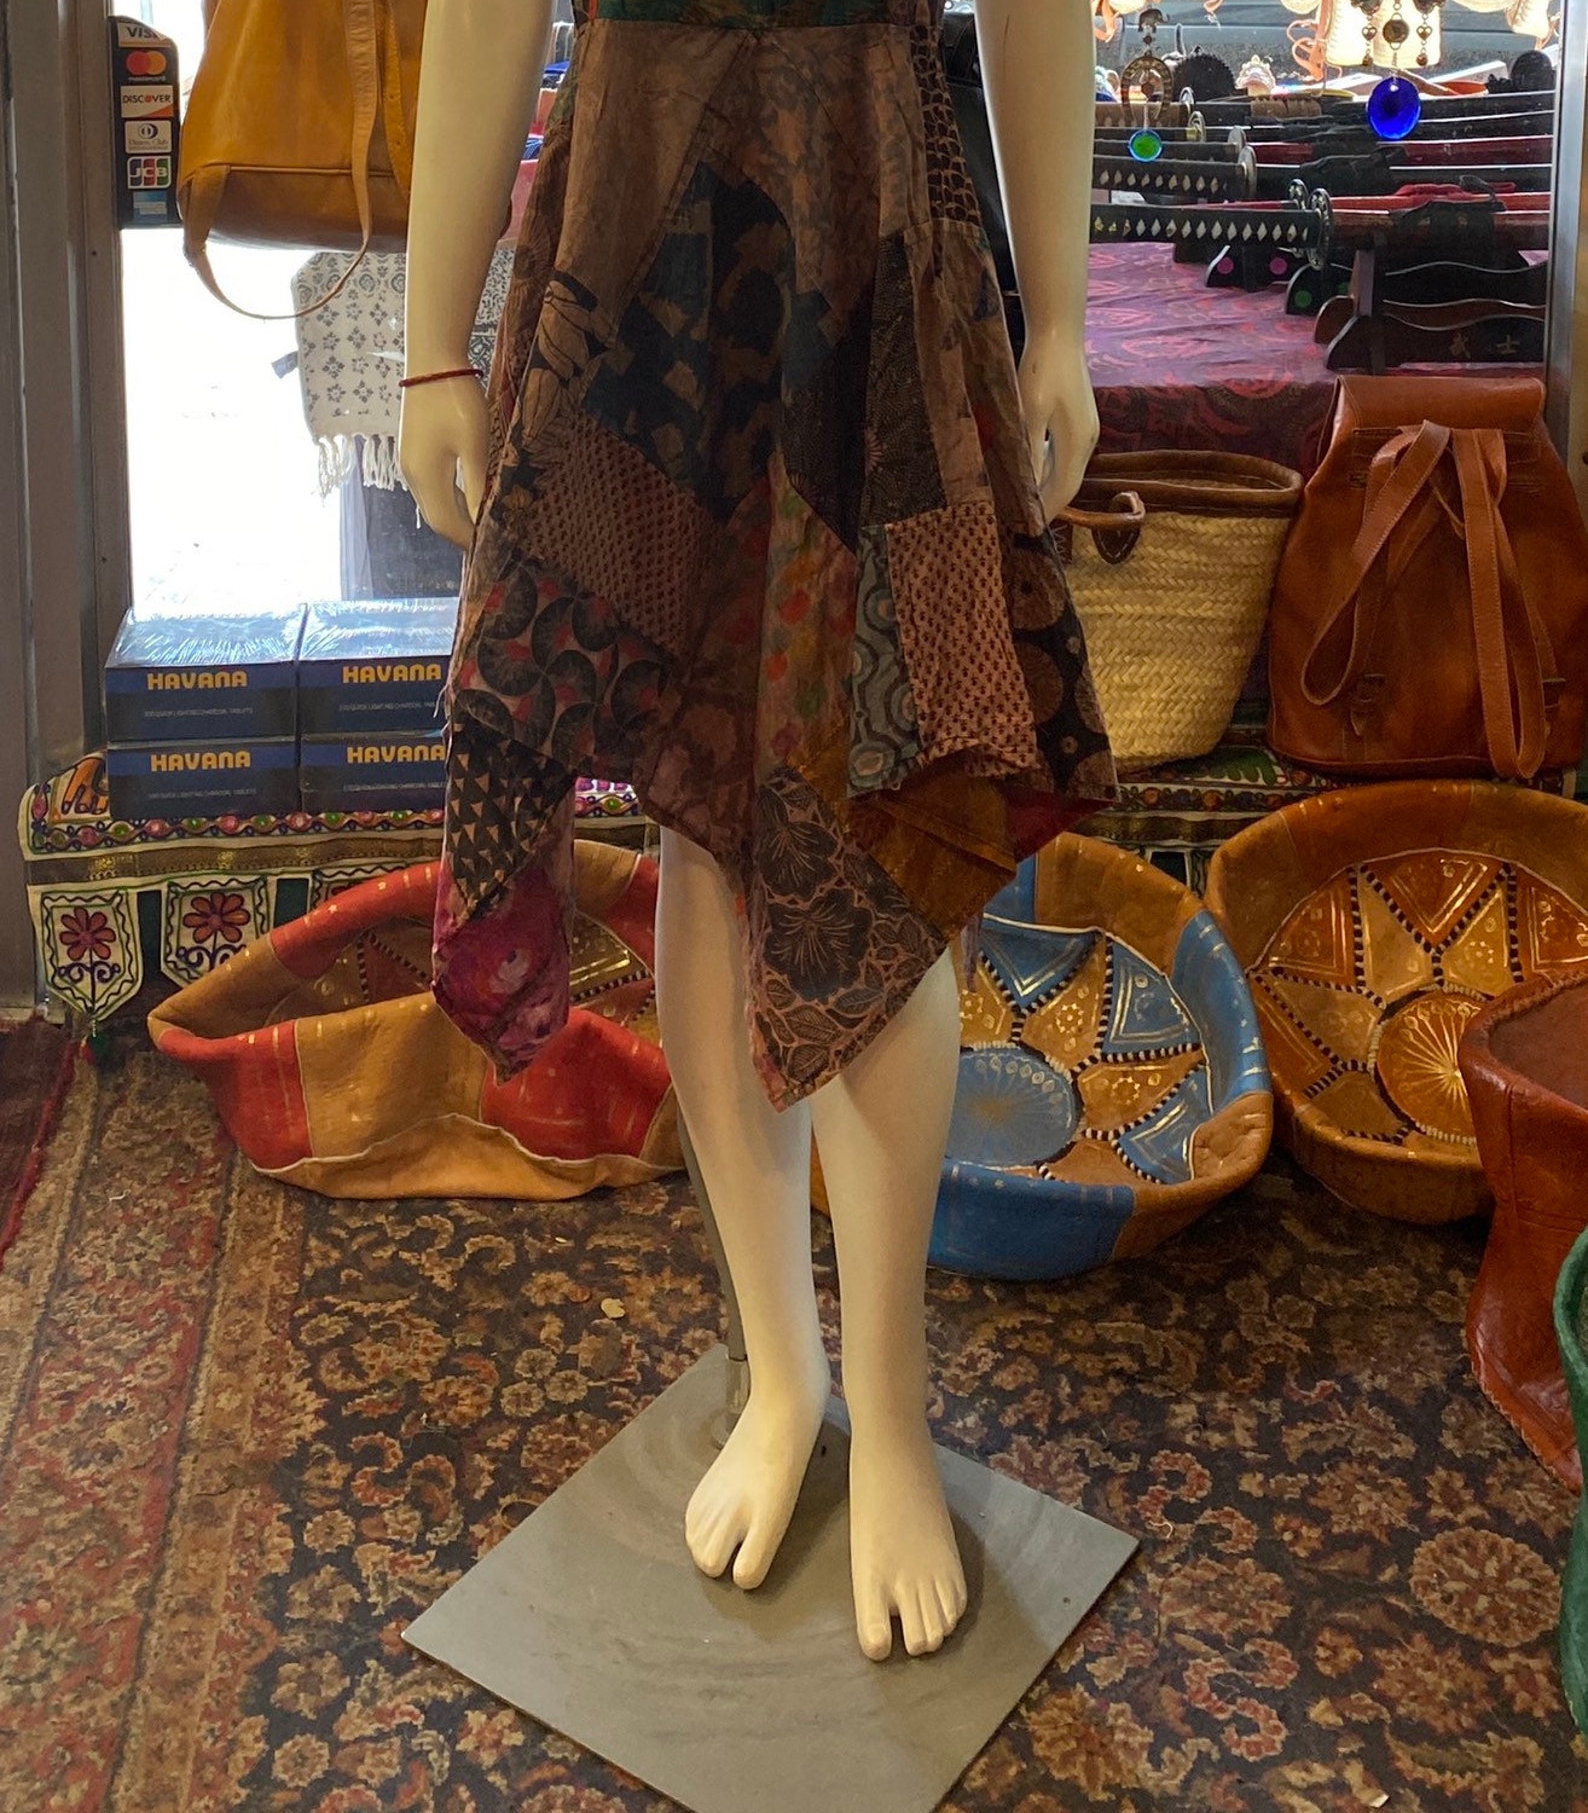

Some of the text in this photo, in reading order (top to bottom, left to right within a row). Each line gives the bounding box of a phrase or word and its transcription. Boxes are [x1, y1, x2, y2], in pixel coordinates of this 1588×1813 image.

[122, 94, 171, 104] DISCOVER
[129, 167, 168, 178] JCB
[147, 671, 248, 690] HAVANA
[343, 663, 442, 683] HAVANA
[150, 751, 251, 772] HAVANA
[347, 744, 446, 763] HAVANA
